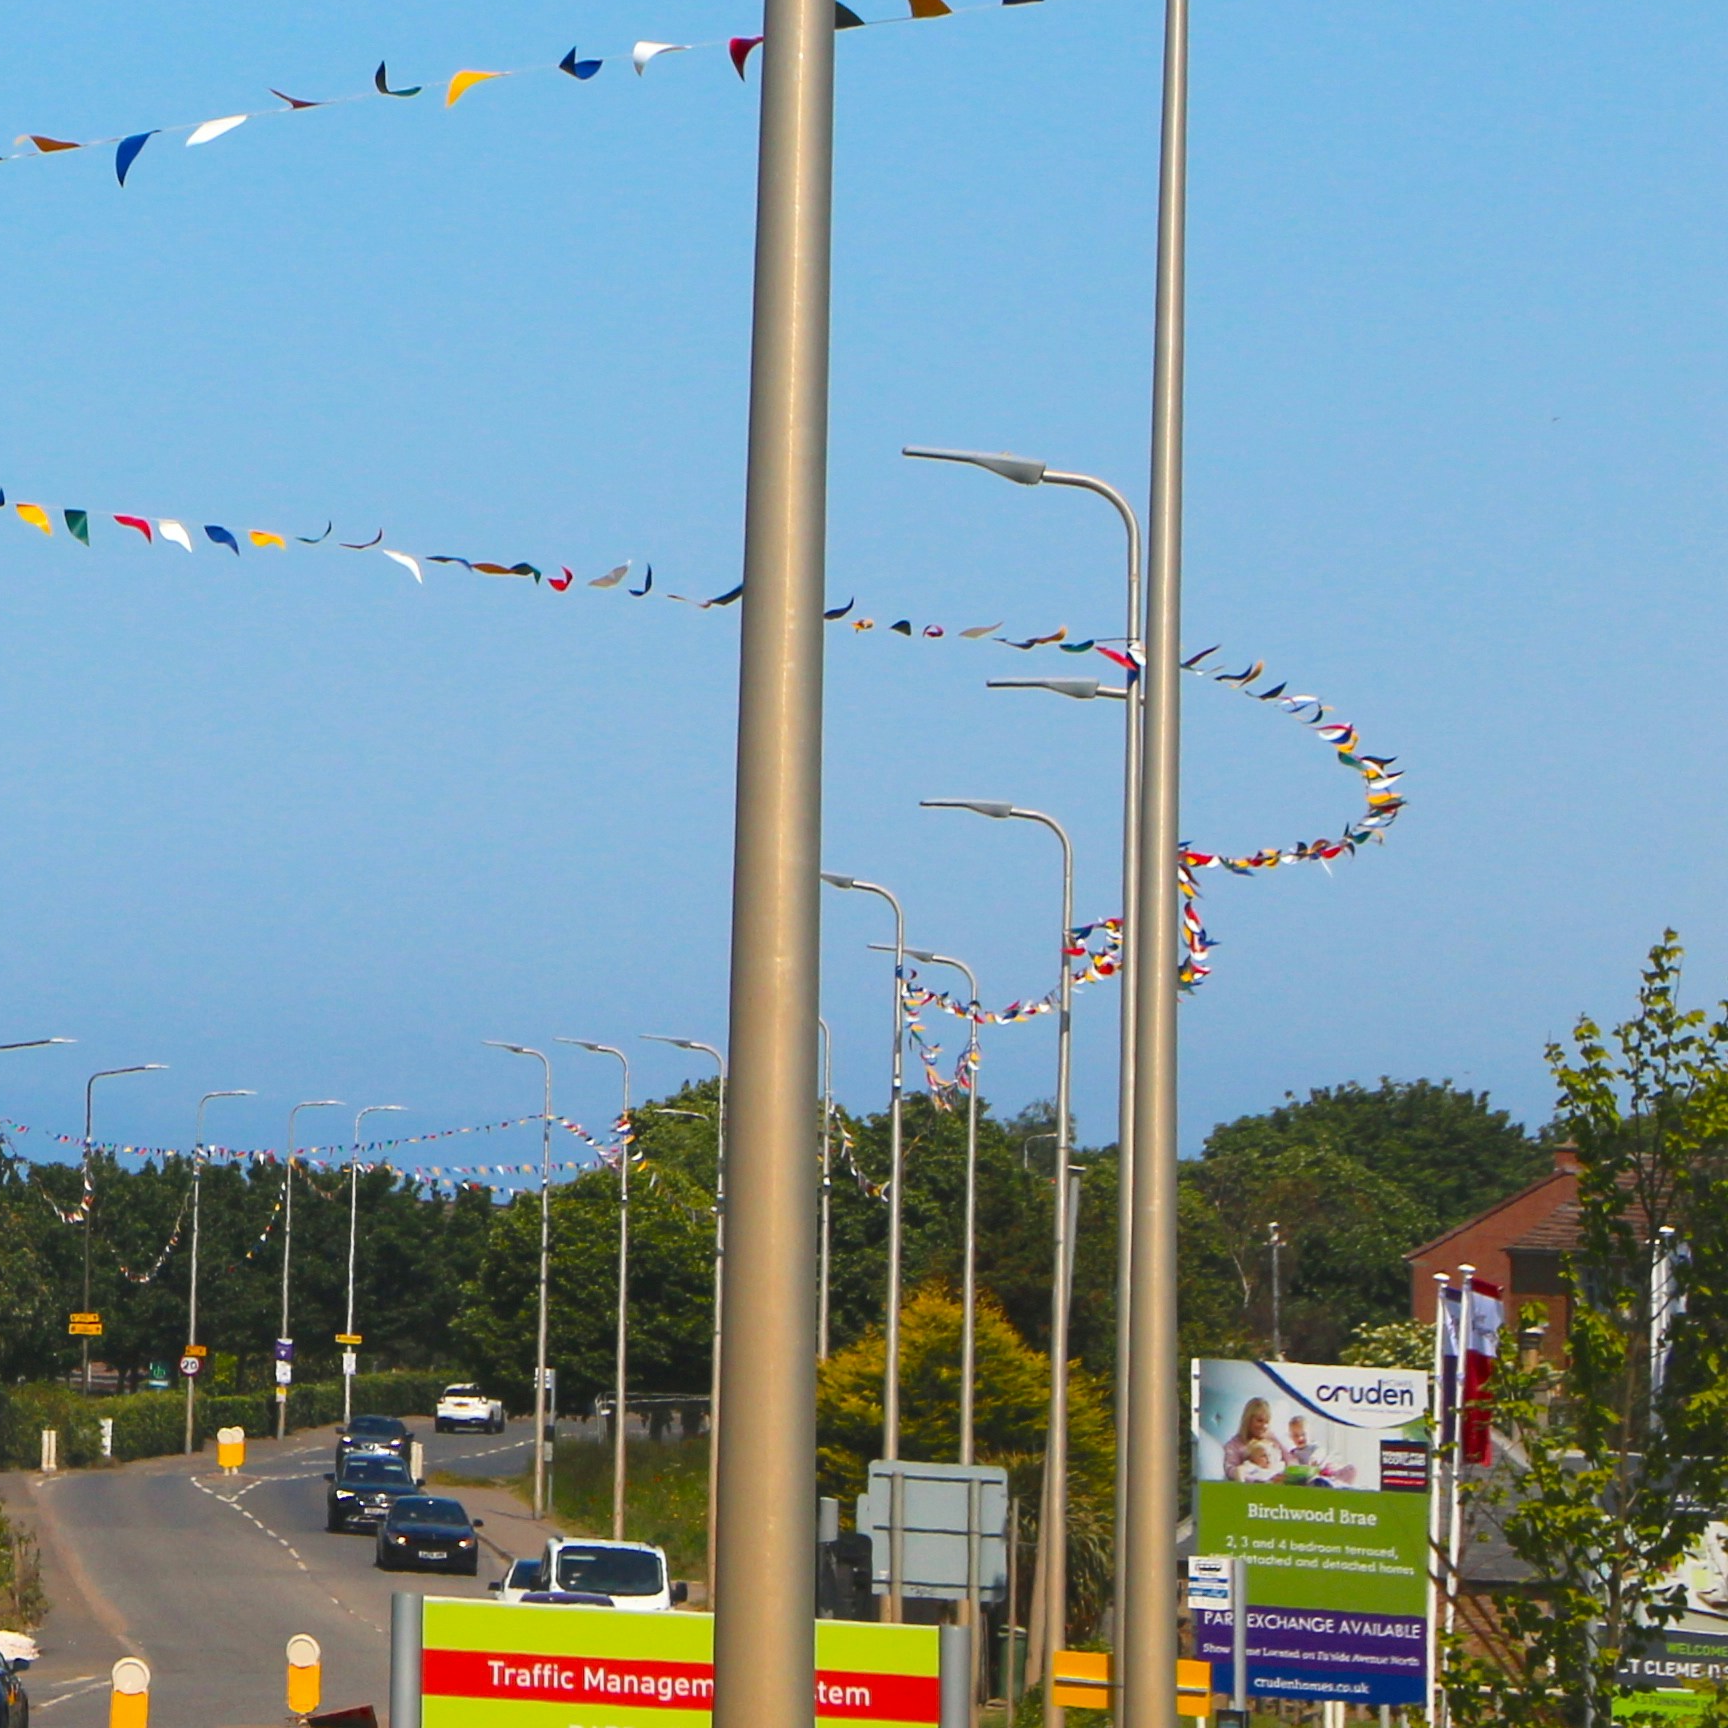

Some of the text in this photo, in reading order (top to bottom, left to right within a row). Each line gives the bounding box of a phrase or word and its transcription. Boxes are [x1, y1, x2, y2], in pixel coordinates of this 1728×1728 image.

[182, 1360, 198, 1370] 20
[1316, 1379, 1414, 1407] cruden
[1247, 1503, 1378, 1526] Birchwood Brae
[1226, 1535, 1400, 1560] 2, 3 and 4 bedroom terraced,
[1294, 1555, 1320, 1569] and
[1321, 1557, 1377, 1574] detached
[1378, 1564, 1415, 1576] homes
[1204, 1611, 1422, 1639] PAR EXCHANGE AVAILABLE
[1202, 1643, 1232, 1655] Show
[1262, 1647, 1301, 1660] Located
[1302, 1651, 1316, 1660] on
[1666, 1642, 1728, 1658] WELCOME
[487, 1659, 574, 1690] Traffic
[583, 1666, 714, 1702] Managem
[1253, 1676, 1370, 1695] crudenhomes.co.uk
